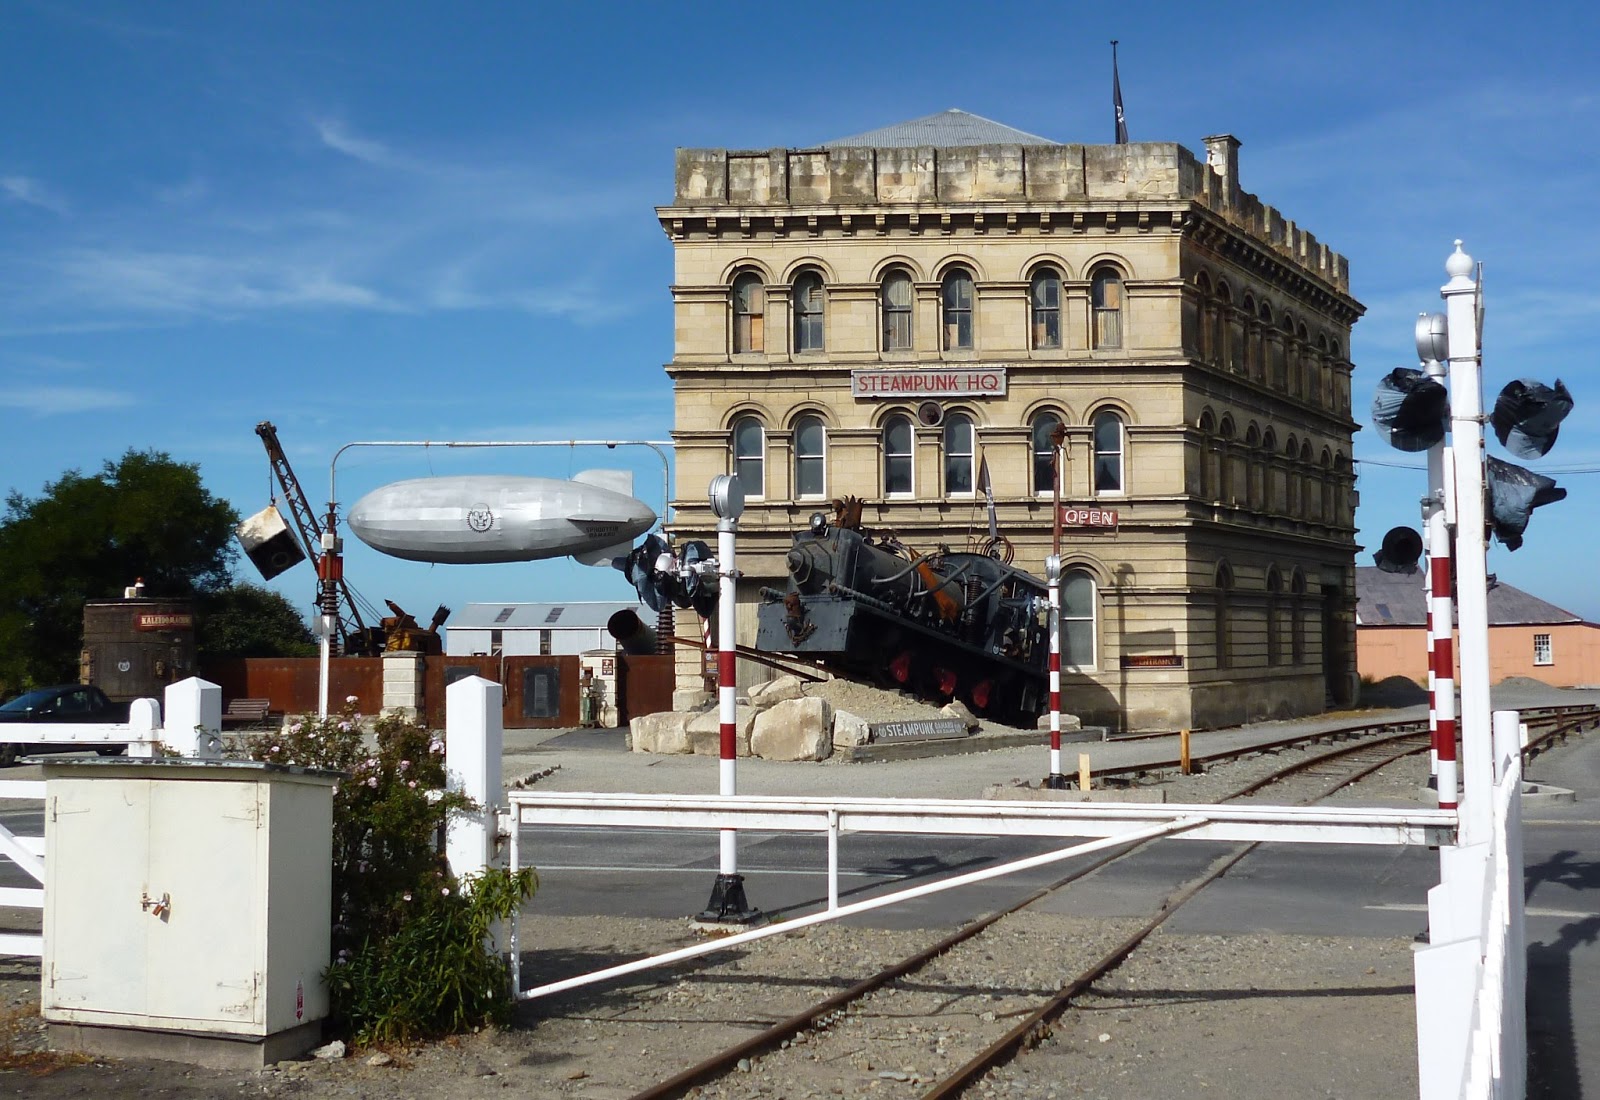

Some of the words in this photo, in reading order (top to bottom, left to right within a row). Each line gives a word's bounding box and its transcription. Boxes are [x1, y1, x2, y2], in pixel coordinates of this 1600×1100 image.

[859, 375, 958, 392] STEAMPUNK
[967, 374, 999, 391] HQ
[1065, 510, 1114, 525] OPEN
[886, 722, 936, 737] STEAMPUNK
